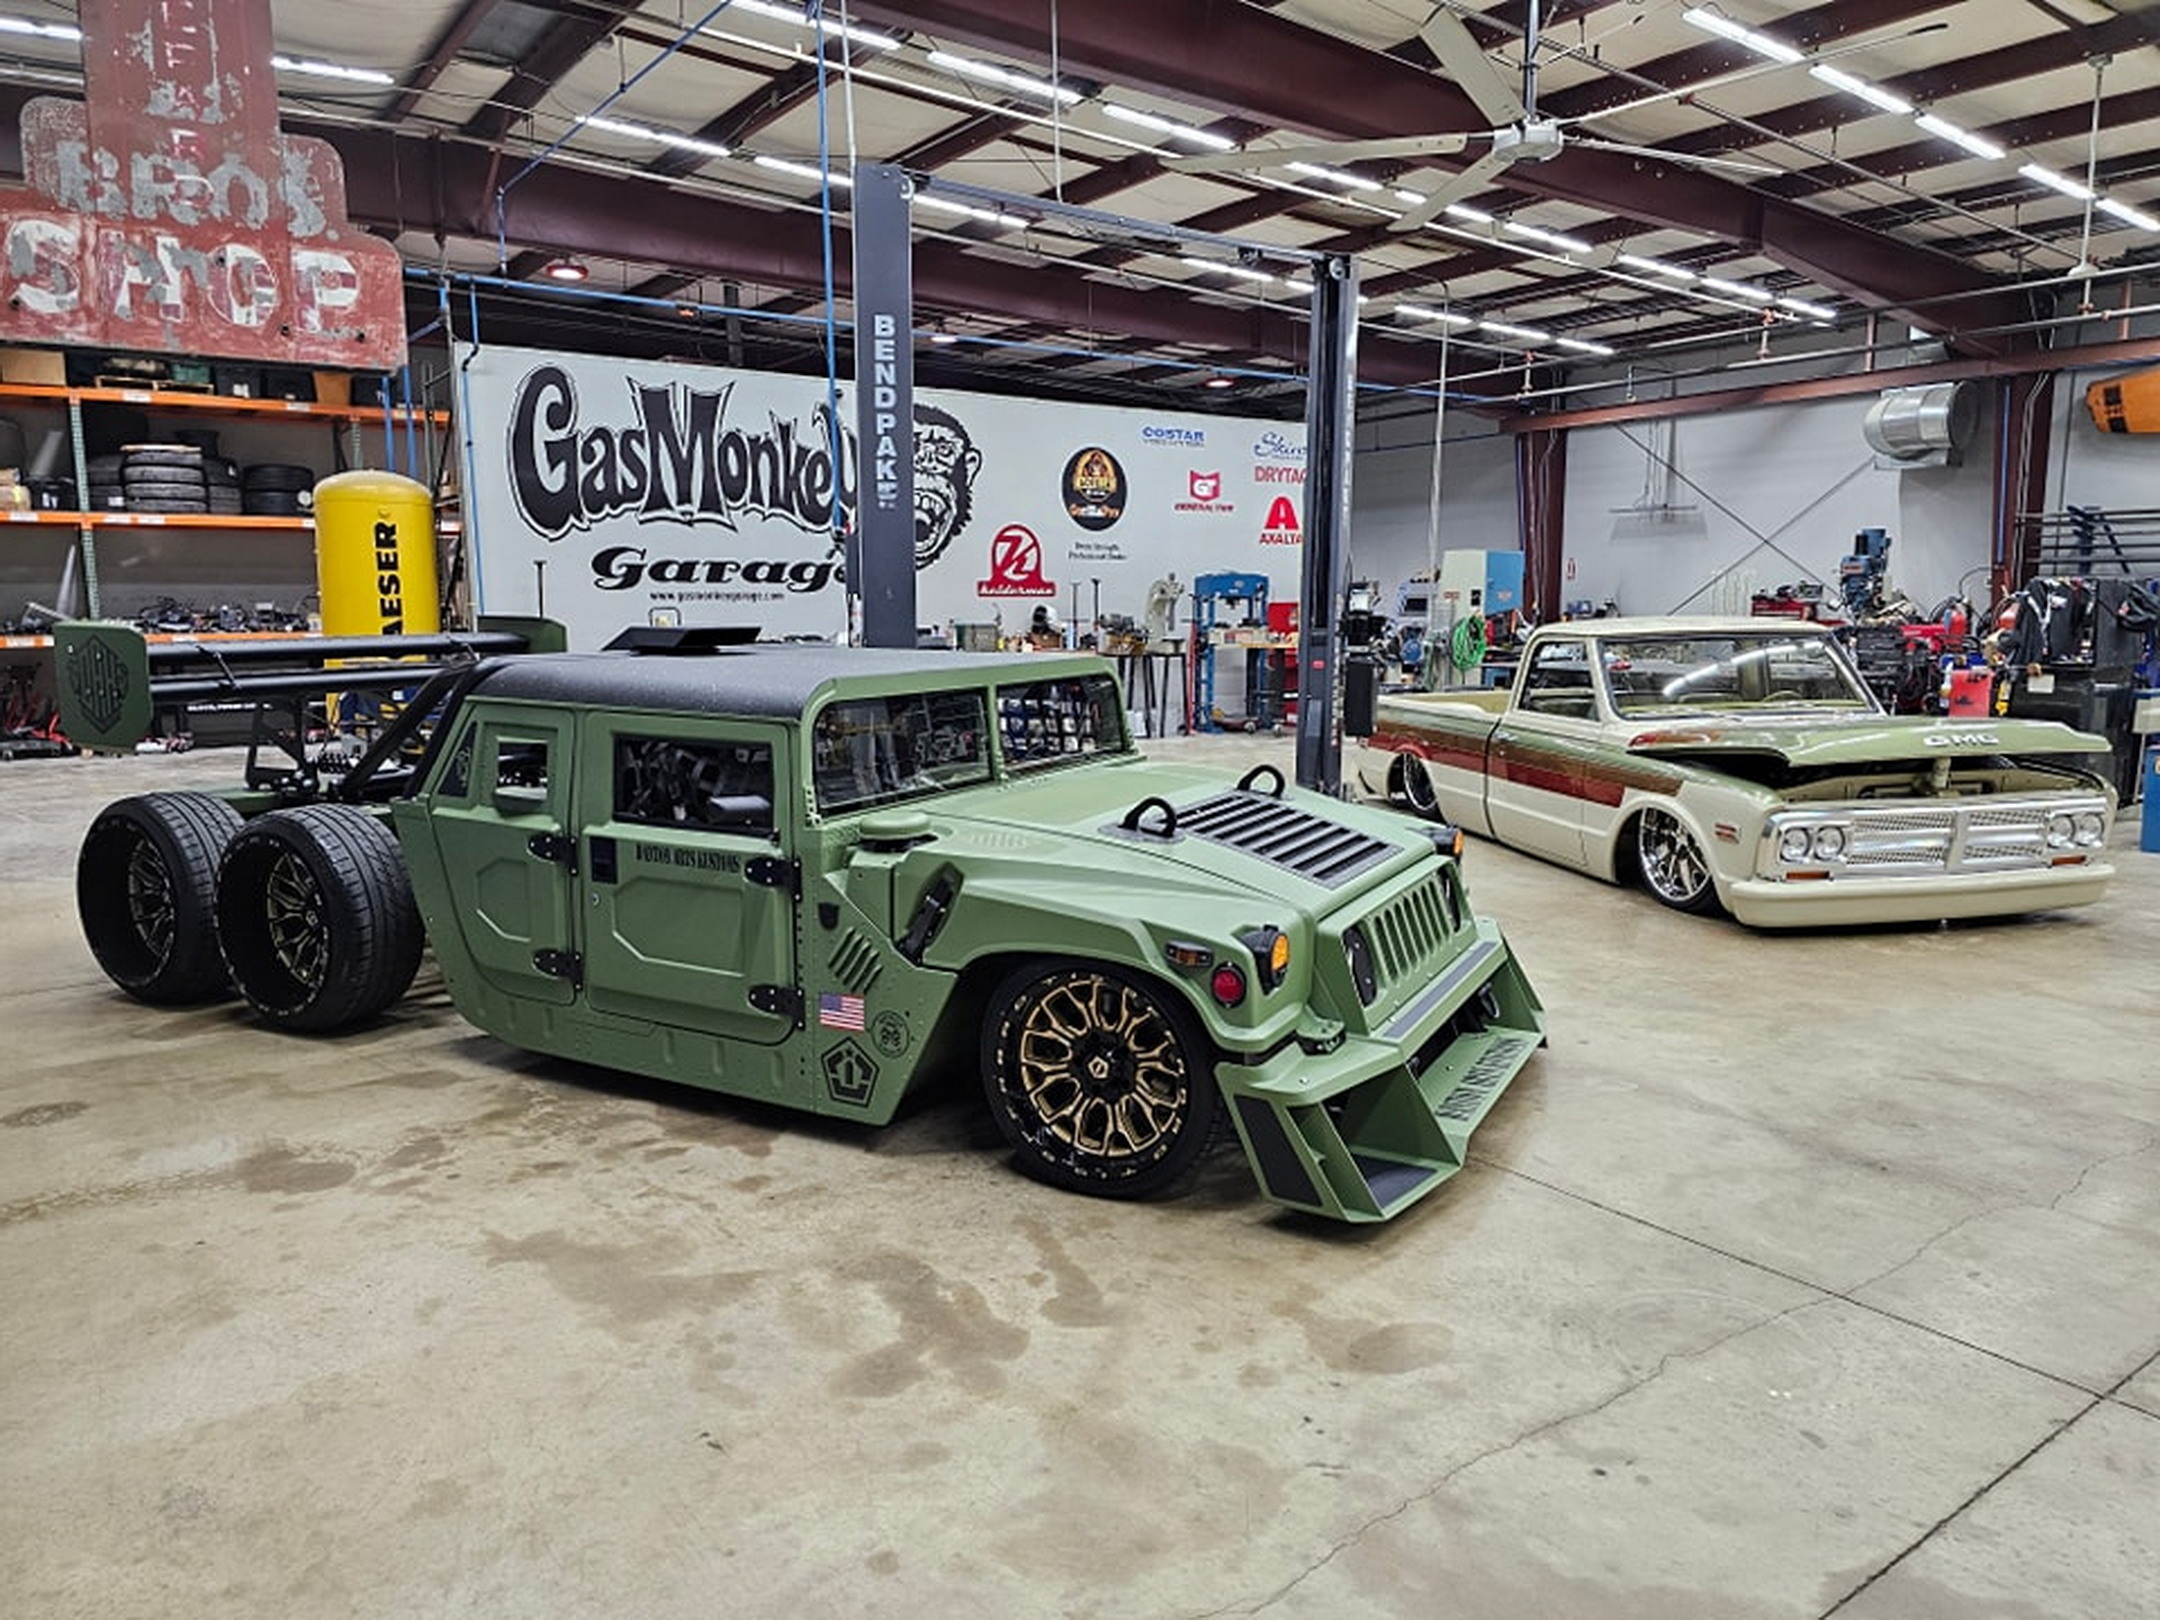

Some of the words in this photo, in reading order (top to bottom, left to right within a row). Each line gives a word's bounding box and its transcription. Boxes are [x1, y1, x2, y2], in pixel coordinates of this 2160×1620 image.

[873, 314, 898, 480] BENDPAK
[1142, 426, 1205, 443] COSTAR
[373, 521, 404, 636] AESER
[1923, 734, 2000, 747] GMC
